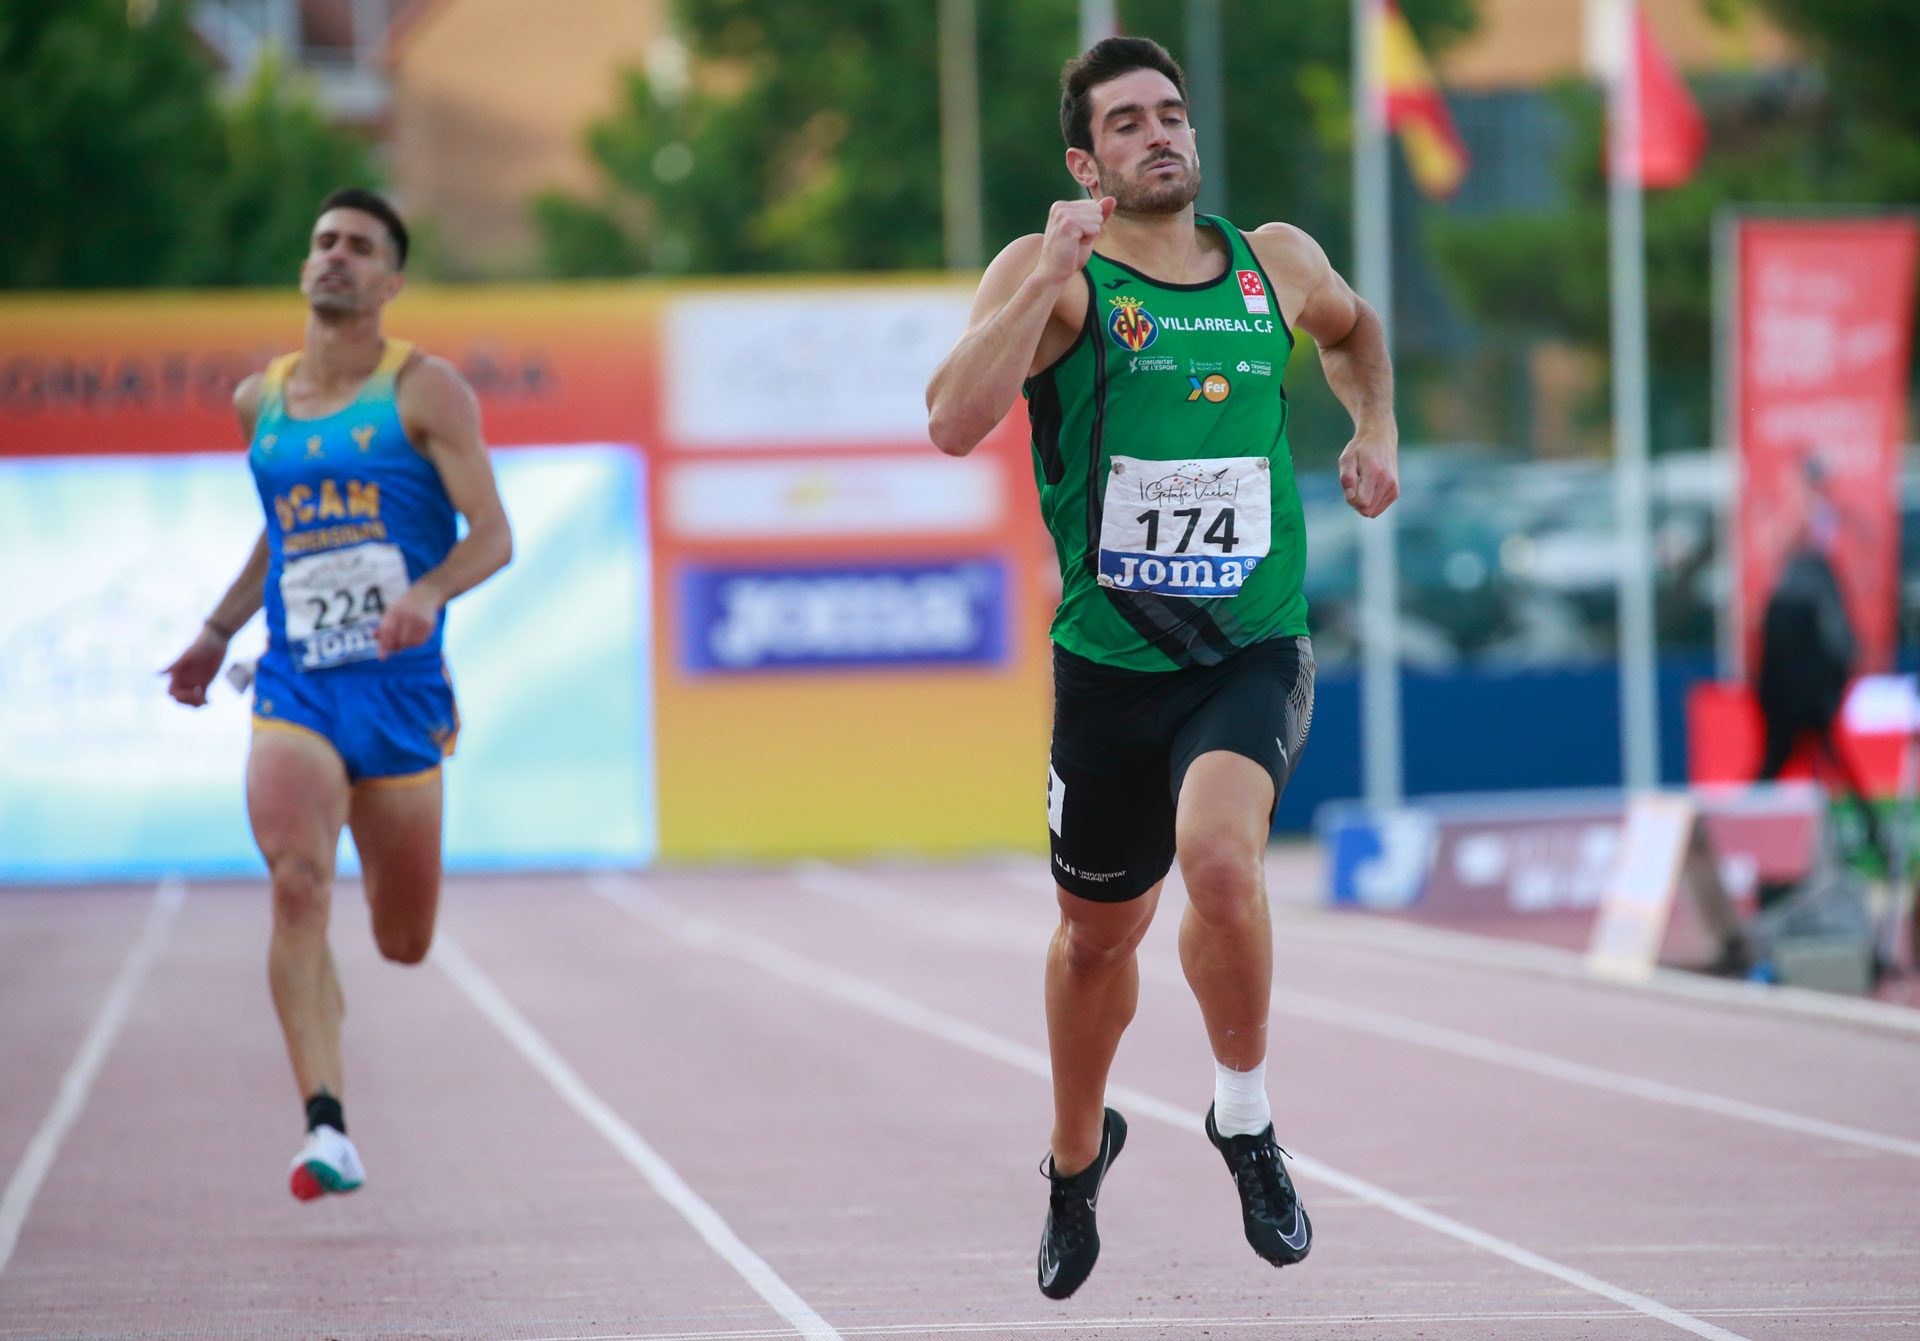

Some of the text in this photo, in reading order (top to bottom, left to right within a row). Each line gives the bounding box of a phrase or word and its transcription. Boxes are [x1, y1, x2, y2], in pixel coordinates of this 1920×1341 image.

[1158, 316, 1252, 332] VILLARREAL
[1205, 381, 1226, 393] Fer
[1136, 507, 1239, 554] 174
[305, 586, 387, 631] 224
